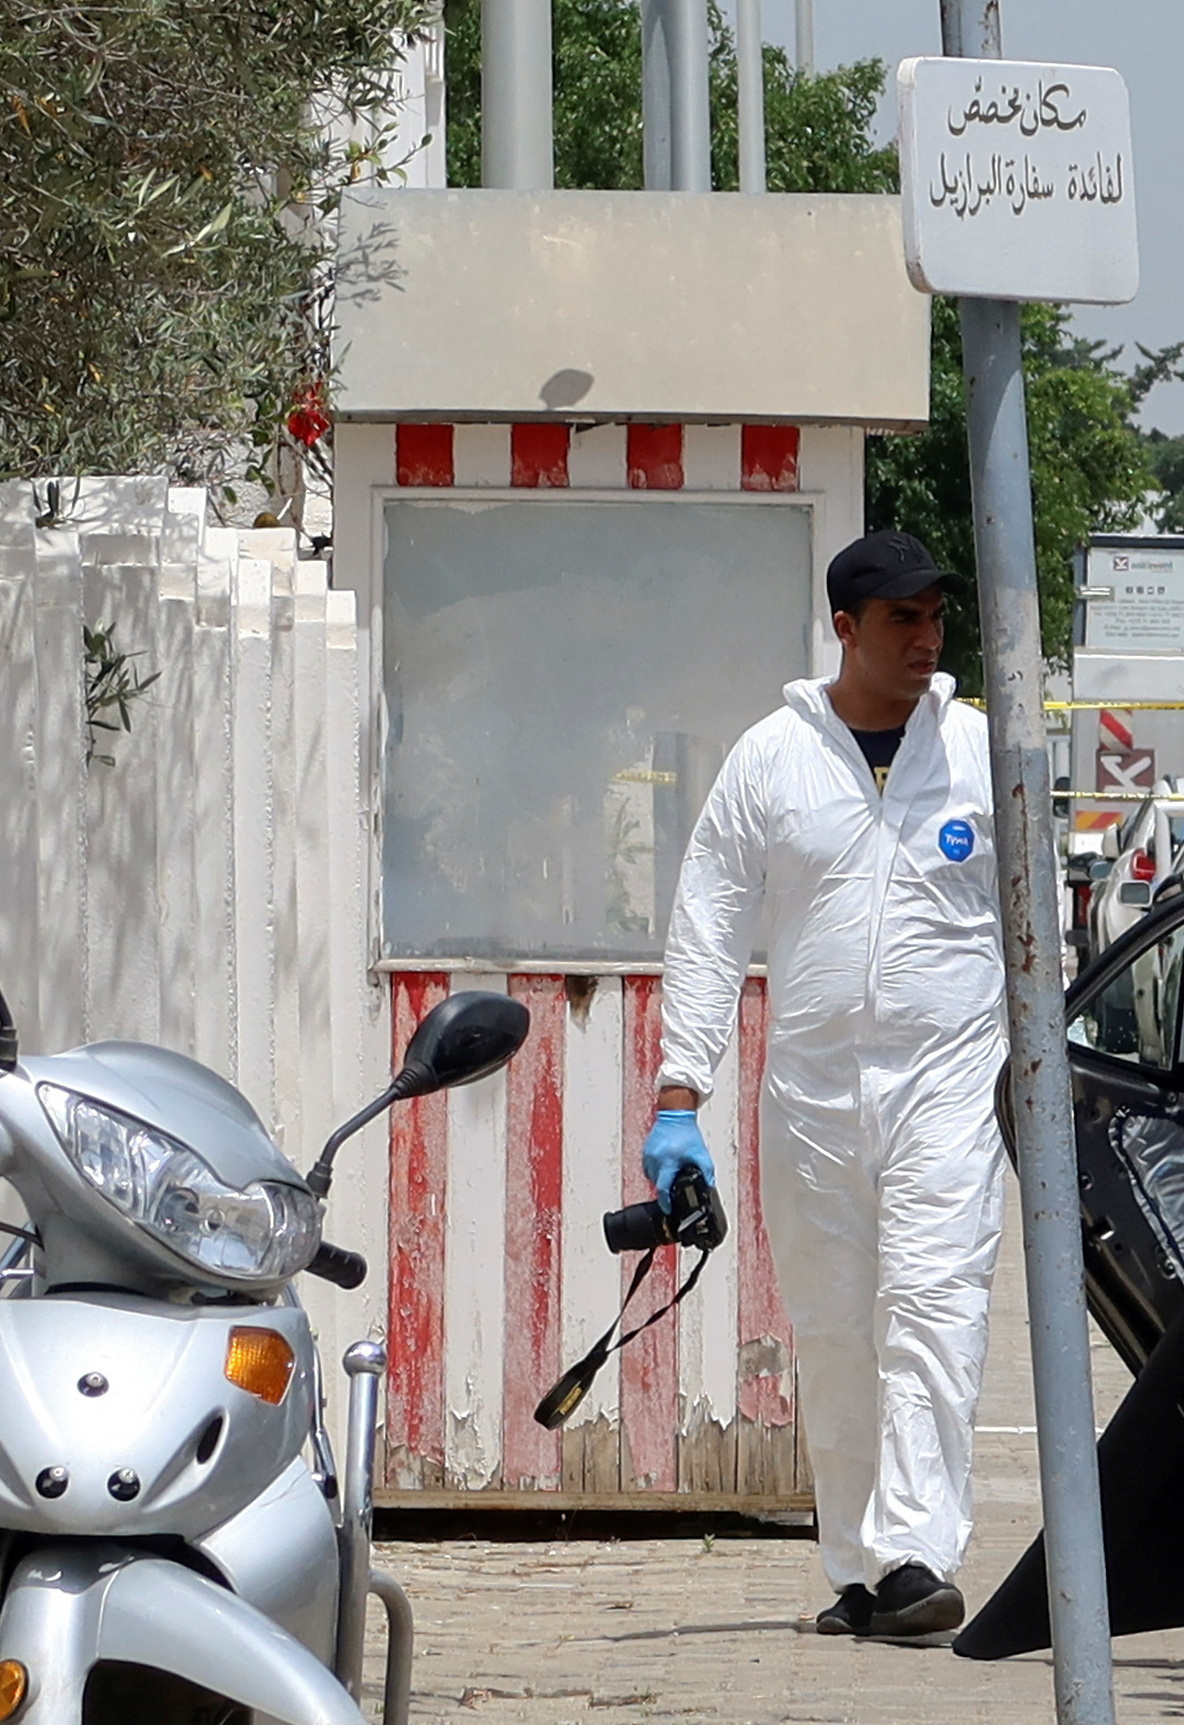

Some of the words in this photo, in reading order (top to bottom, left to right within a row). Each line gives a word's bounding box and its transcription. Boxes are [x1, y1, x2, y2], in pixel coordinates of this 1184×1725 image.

[1020, 80, 1087, 136] مكان
[929, 152, 1001, 221] البرازيل
[1005, 153, 1054, 215] سفارة
[1068, 151, 1123, 204] لفائدة
